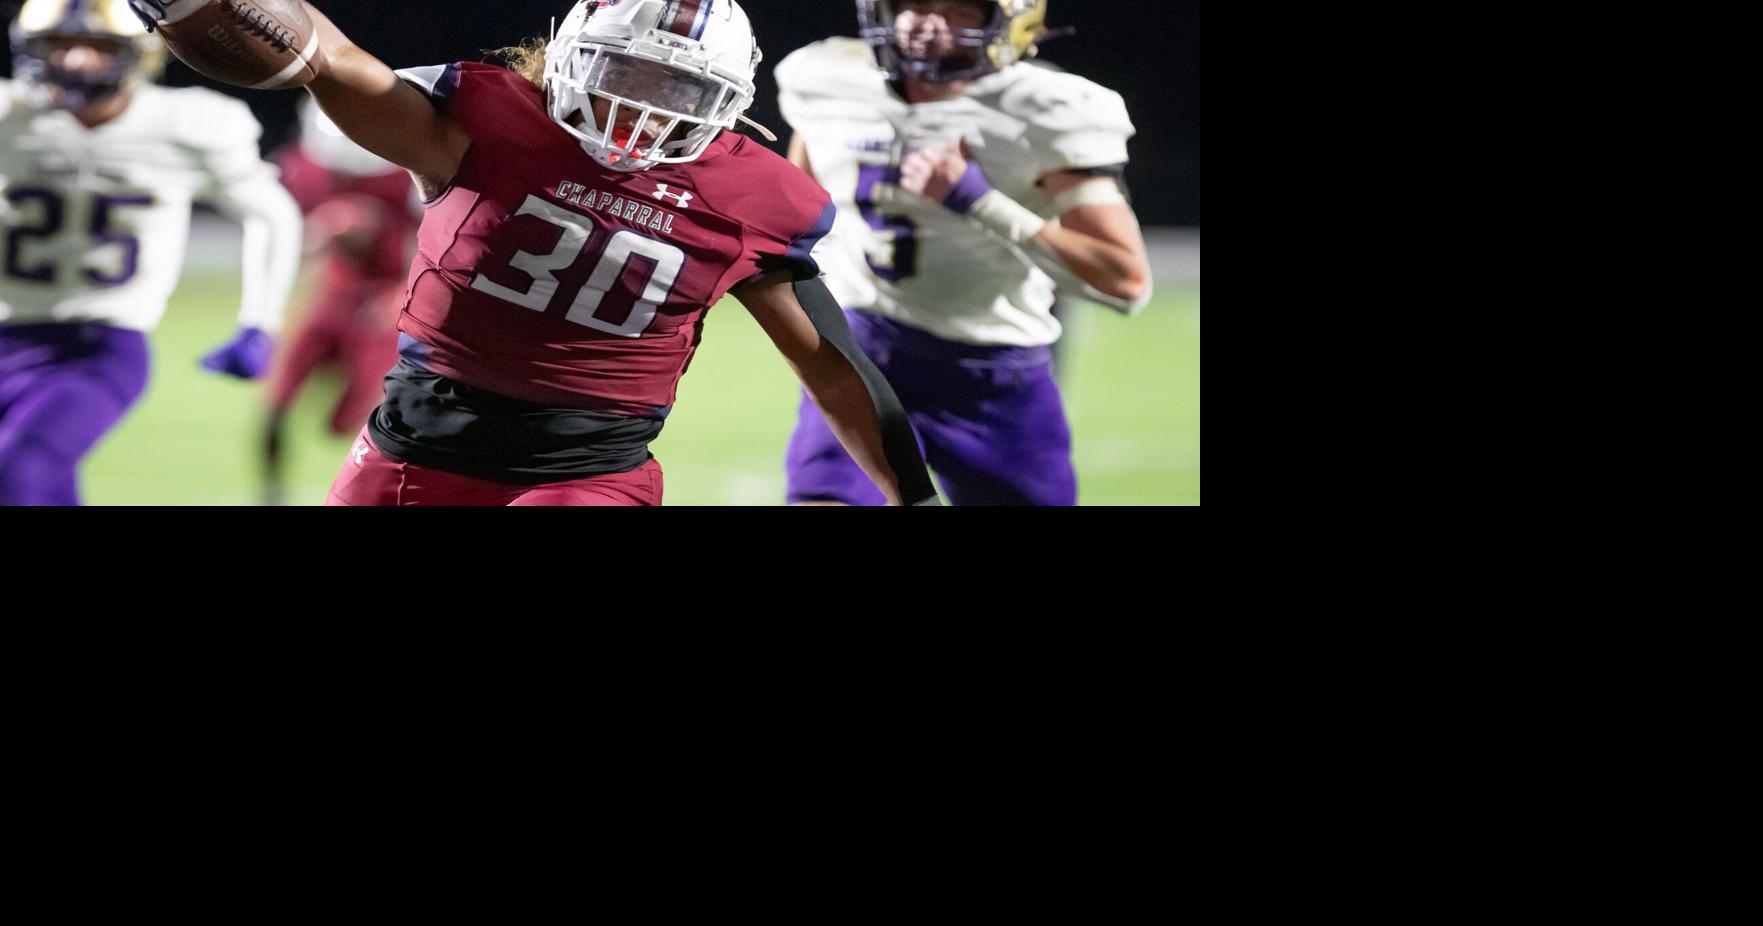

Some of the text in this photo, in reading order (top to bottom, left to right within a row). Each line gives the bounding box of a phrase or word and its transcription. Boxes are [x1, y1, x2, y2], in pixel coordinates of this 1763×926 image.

[5, 186, 157, 287] 25
[555, 180, 673, 234] CHAPARRAL
[855, 161, 918, 282] 5
[470, 194, 685, 338] 30
